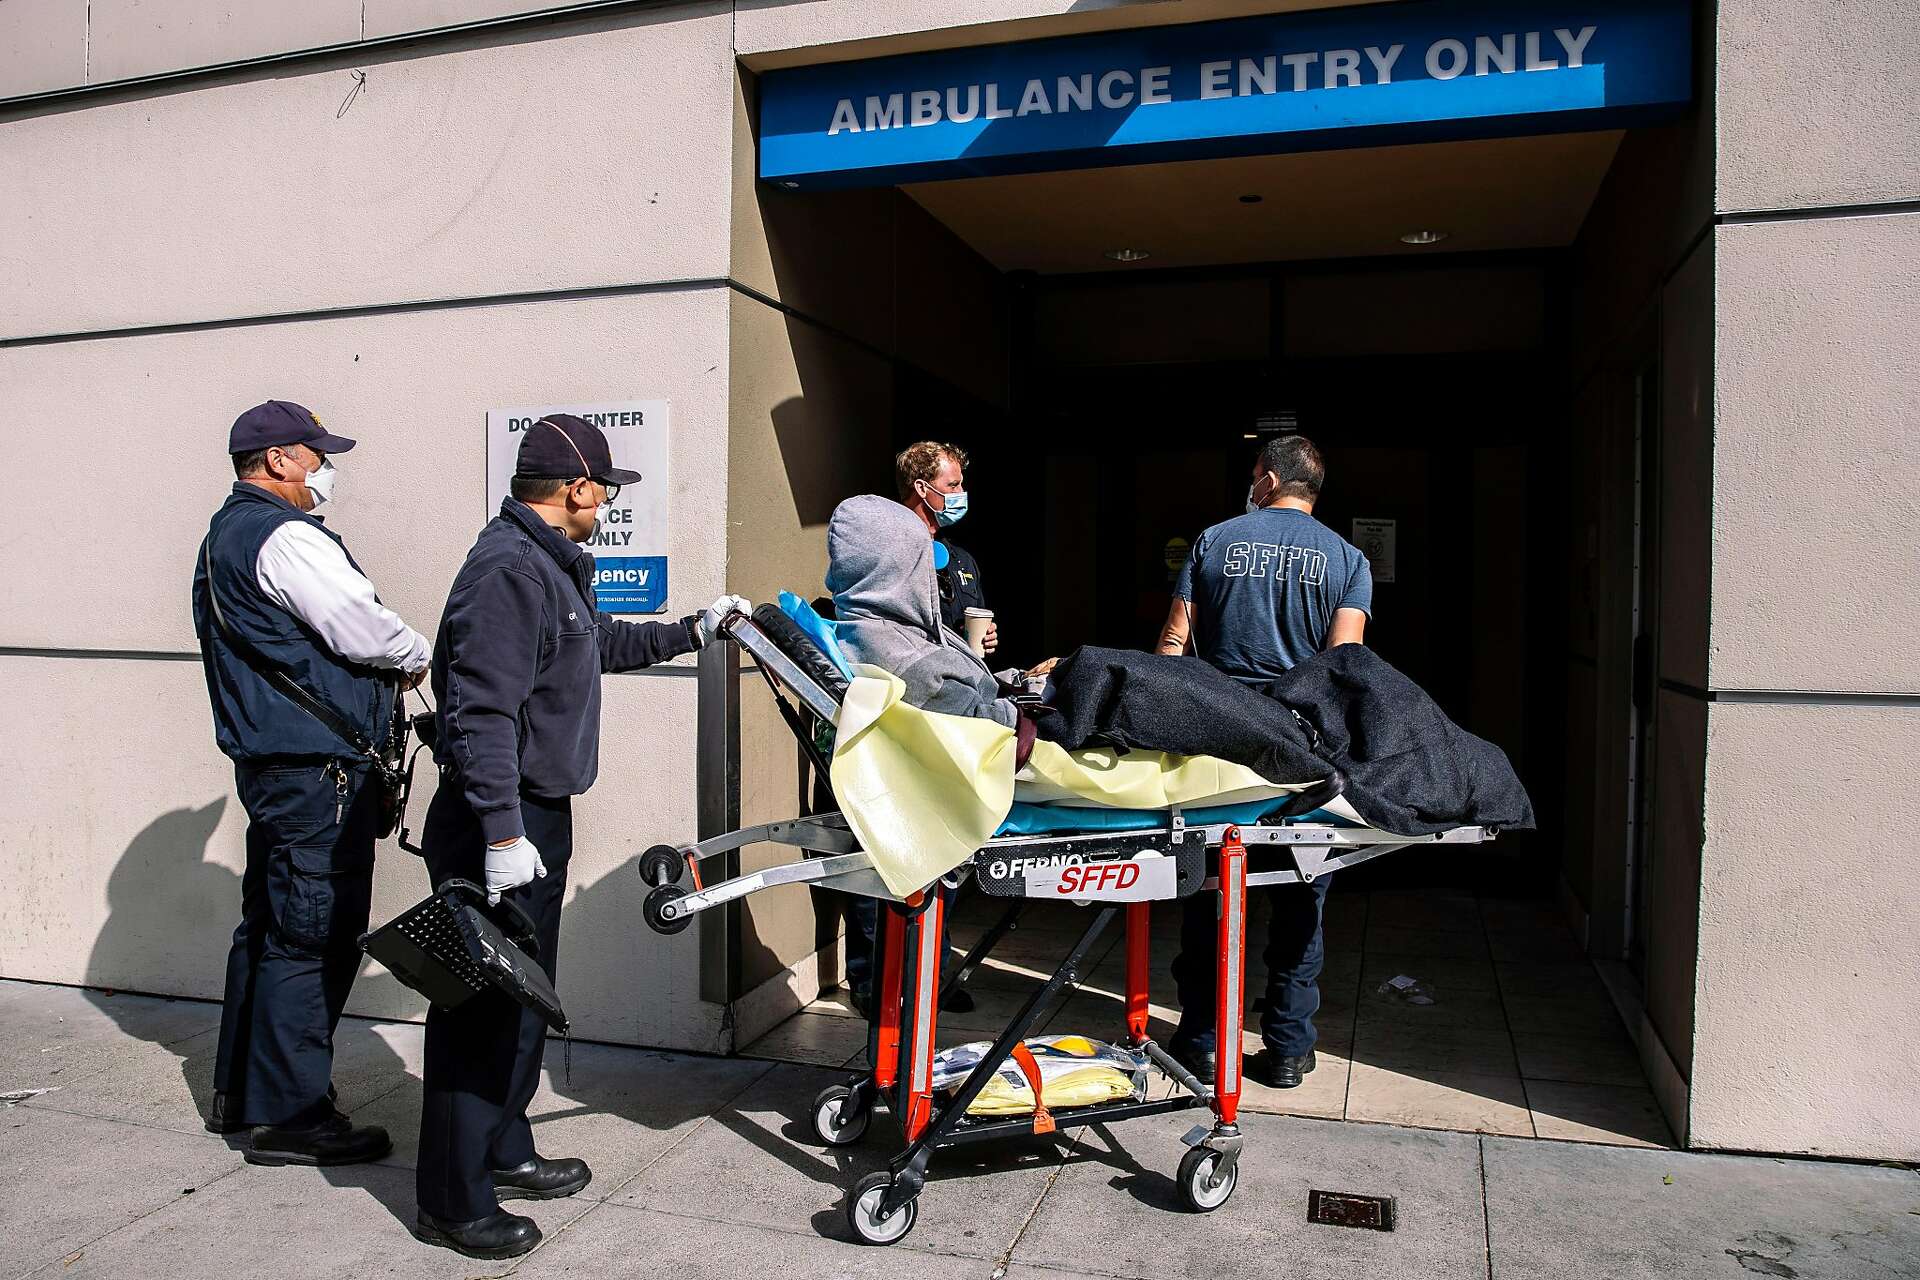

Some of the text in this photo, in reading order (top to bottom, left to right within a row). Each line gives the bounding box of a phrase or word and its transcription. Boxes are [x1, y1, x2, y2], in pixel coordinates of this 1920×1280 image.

[828, 26, 1597, 135] AMBULANCE ENTRY ONLY
[508, 417, 534, 432] DO
[1223, 541, 1328, 586] SFFD
[1057, 863, 1140, 894] SFFD
